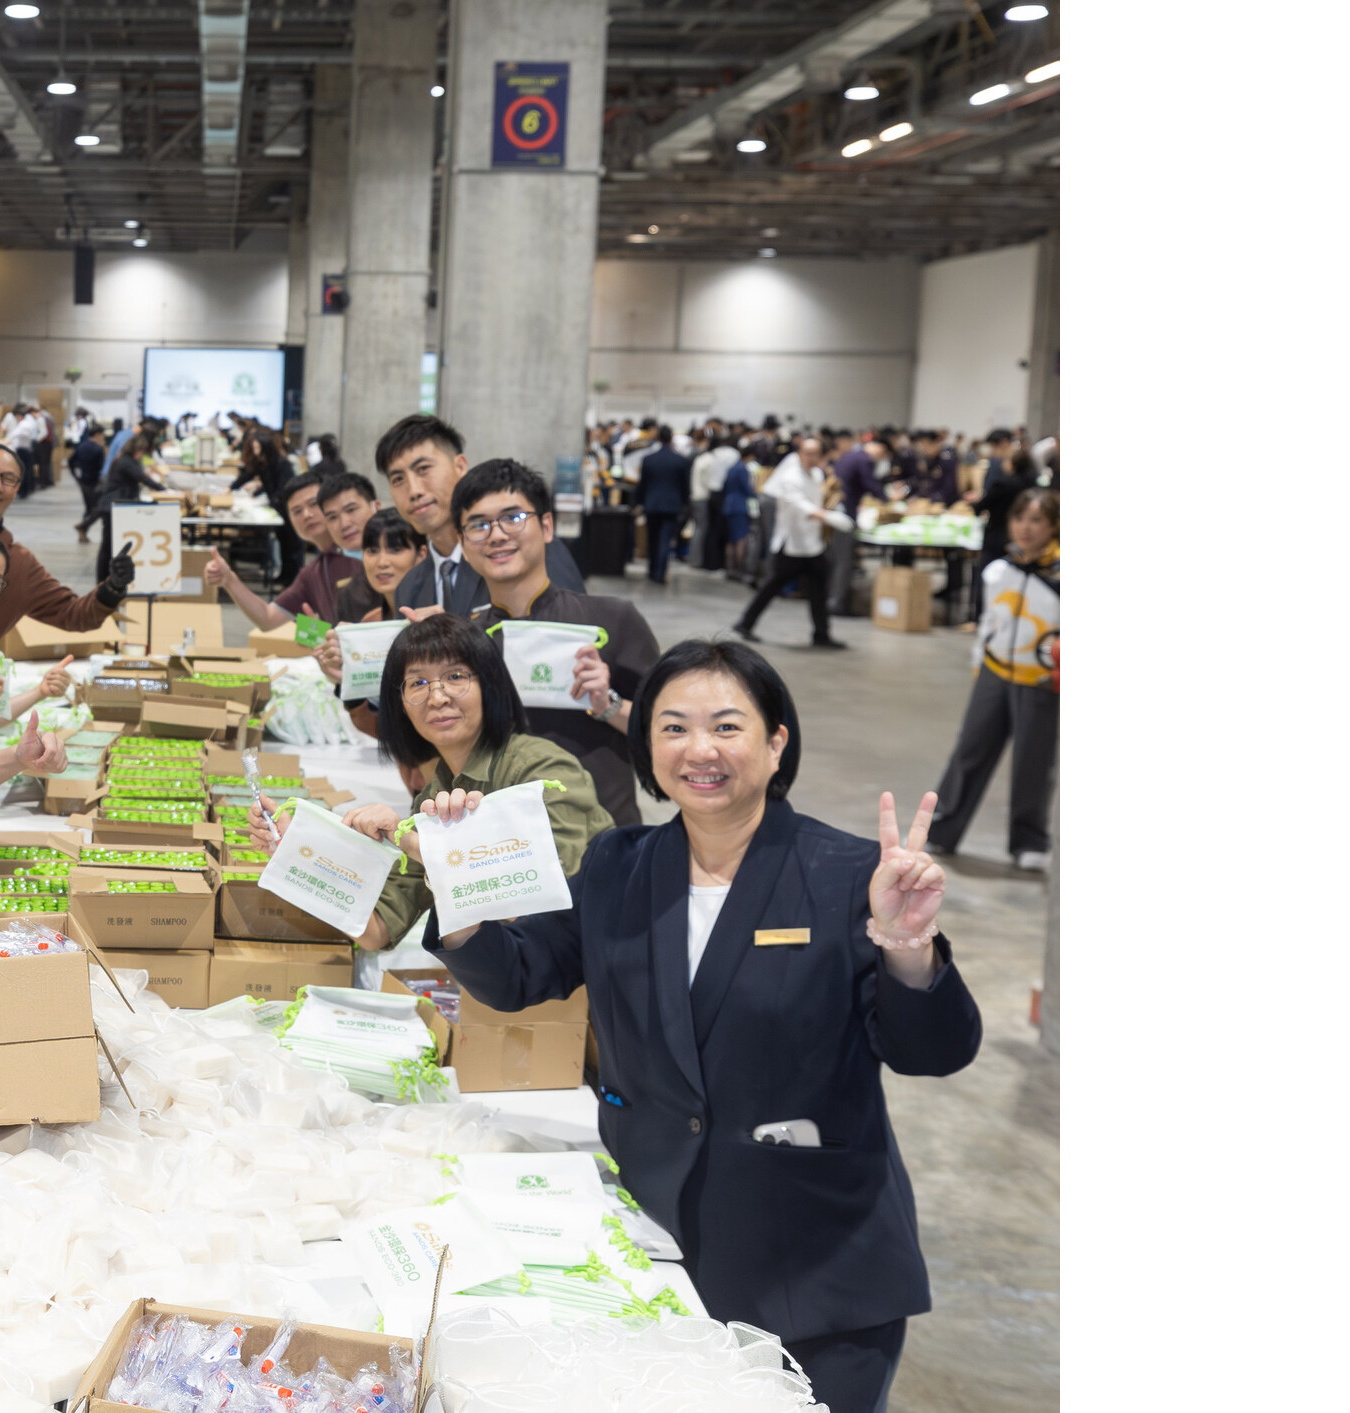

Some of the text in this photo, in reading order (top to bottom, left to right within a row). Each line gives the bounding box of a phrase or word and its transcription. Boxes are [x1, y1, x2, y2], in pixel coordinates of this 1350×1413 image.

[521, 110, 541, 134] 6
[122, 530, 173, 567] 23
[468, 838, 531, 861] Sands
[469, 849, 533, 870] SANDS CARES
[284, 874, 313, 893] SANDS
[288, 865, 356, 905] 金沙環保360
[313, 861, 362, 889] SANDS CARES
[451, 869, 539, 900] 金沙環保360
[454, 895, 492, 910] SANDS
[150, 917, 187, 926] SHAMPOO
